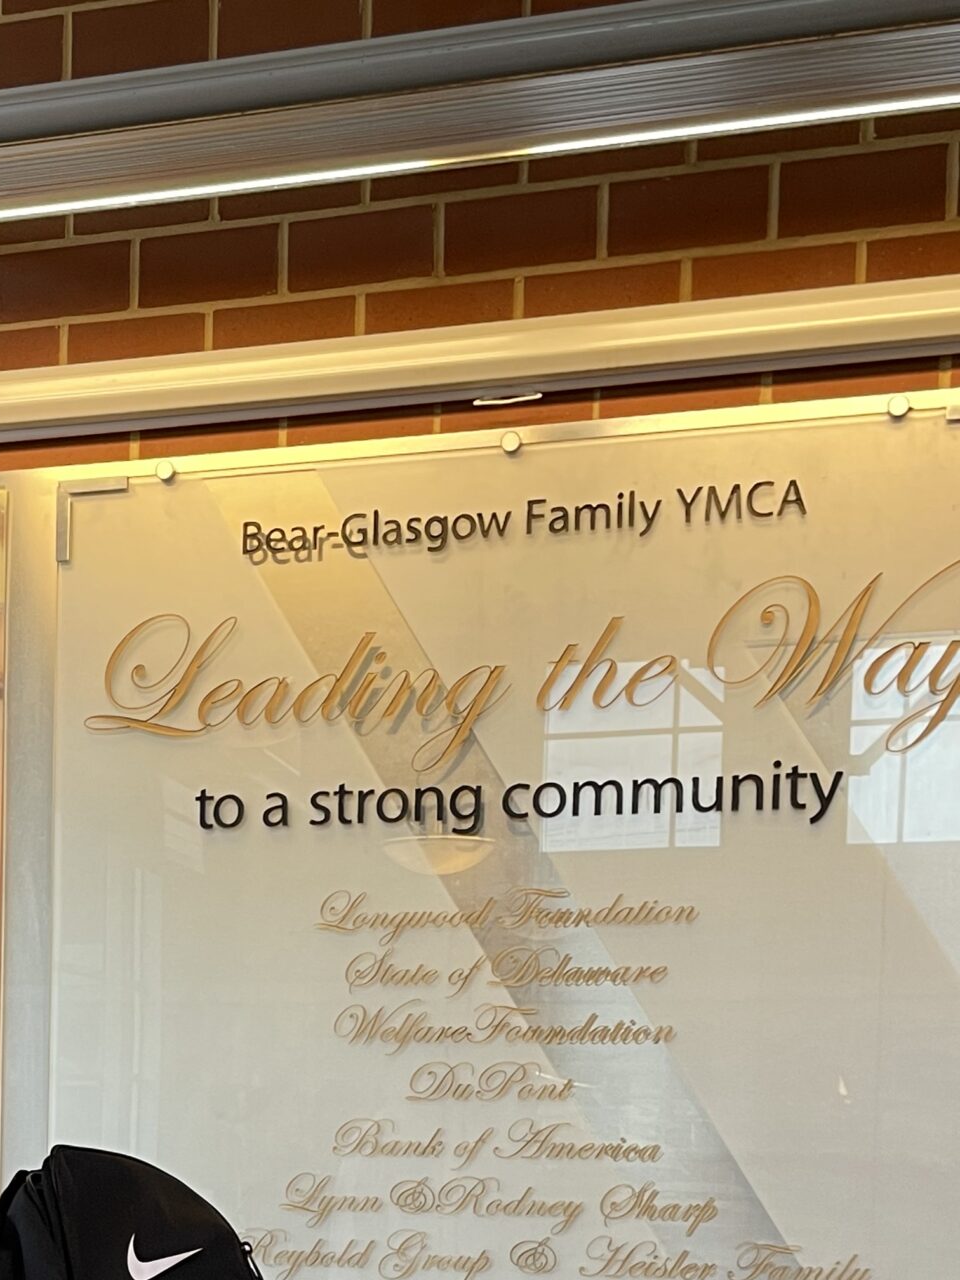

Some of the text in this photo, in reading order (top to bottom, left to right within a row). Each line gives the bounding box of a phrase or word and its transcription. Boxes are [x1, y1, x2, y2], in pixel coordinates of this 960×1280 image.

[241, 480, 808, 553] Bear-Glasgow Family YMCA
[83, 612, 512, 774] Leading
[536, 615, 681, 713] the
[196, 760, 844, 836] to a strong community
[314, 886, 700, 946] Longwood Foundation
[345, 947, 670, 998] State of Delaware
[333, 999, 676, 1056] Welfare Foundation
[332, 1118, 663, 1170] Bank of America
[279, 1172, 719, 1237] Lynn & Rodney Sharp
[509, 1237, 557, 1274] &
